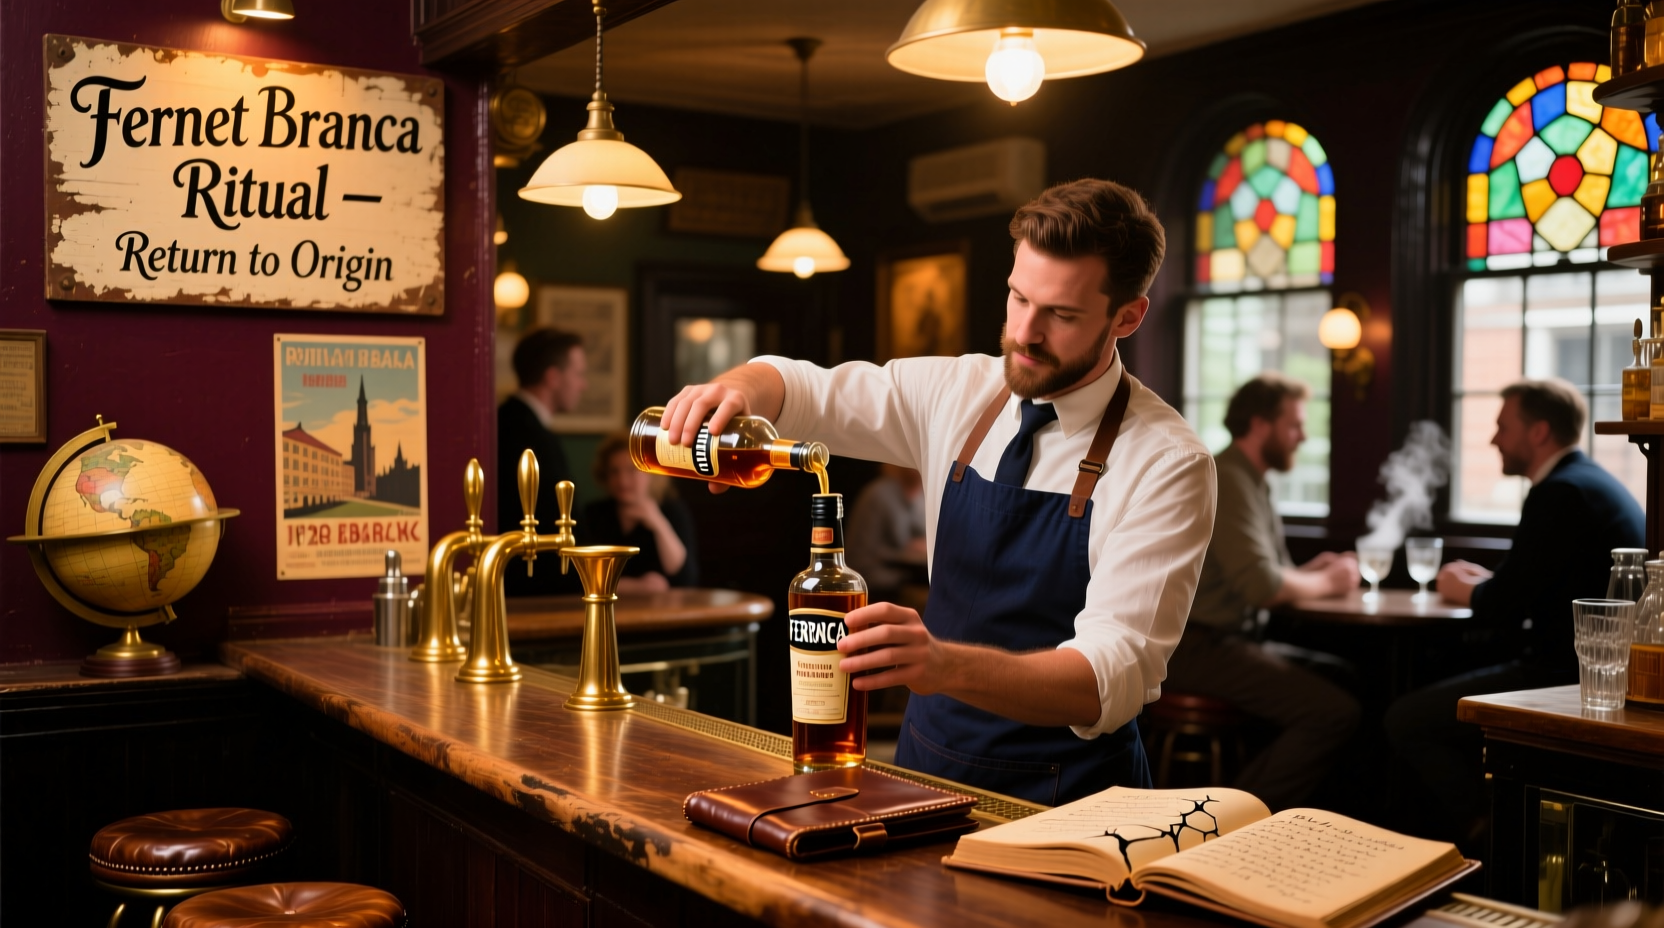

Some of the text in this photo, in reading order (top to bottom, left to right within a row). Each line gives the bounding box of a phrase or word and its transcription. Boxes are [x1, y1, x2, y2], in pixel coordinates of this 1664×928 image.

[70, 75, 423, 169] Fernet Branca
[172, 158, 330, 231] Ritual
[115, 230, 393, 293] Return to Origin
